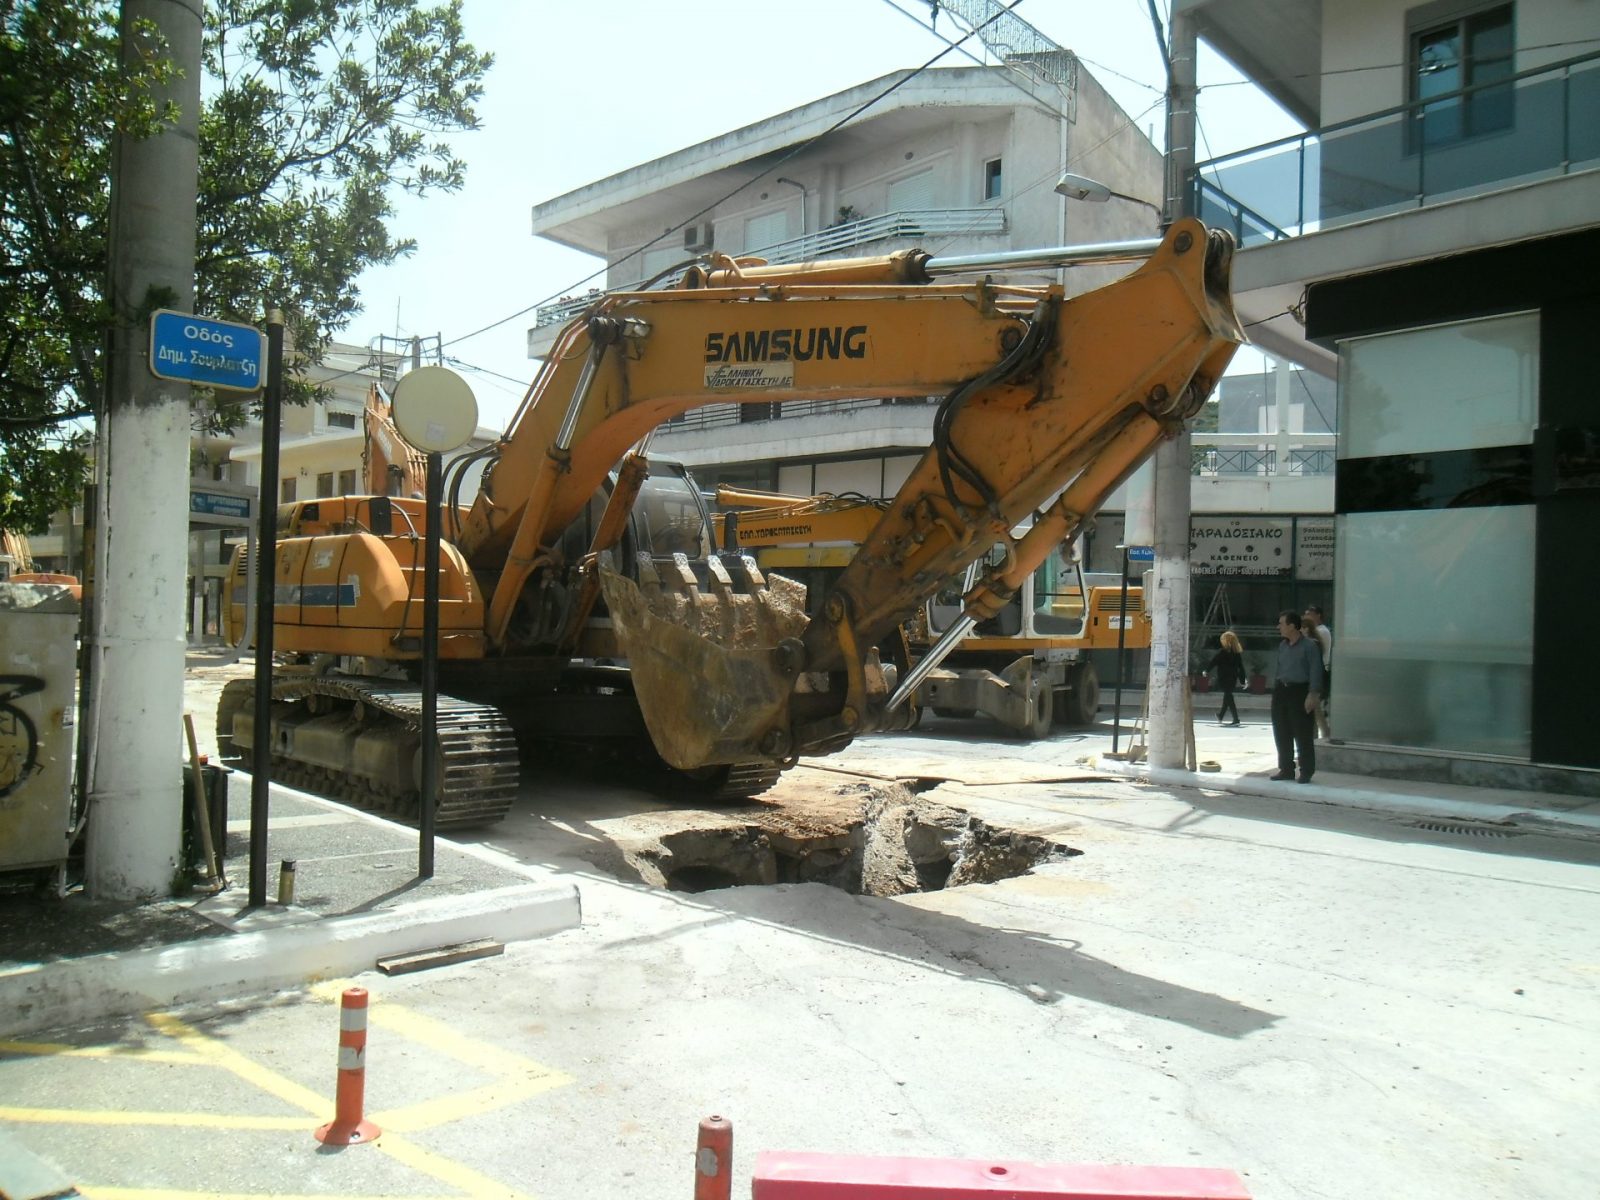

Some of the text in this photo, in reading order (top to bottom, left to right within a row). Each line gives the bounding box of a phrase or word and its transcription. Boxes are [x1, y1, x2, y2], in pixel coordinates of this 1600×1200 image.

[184, 325, 234, 348] Οδός
[704, 325, 867, 363] SAMSUNG
[158, 345, 187, 364] Δημ.
